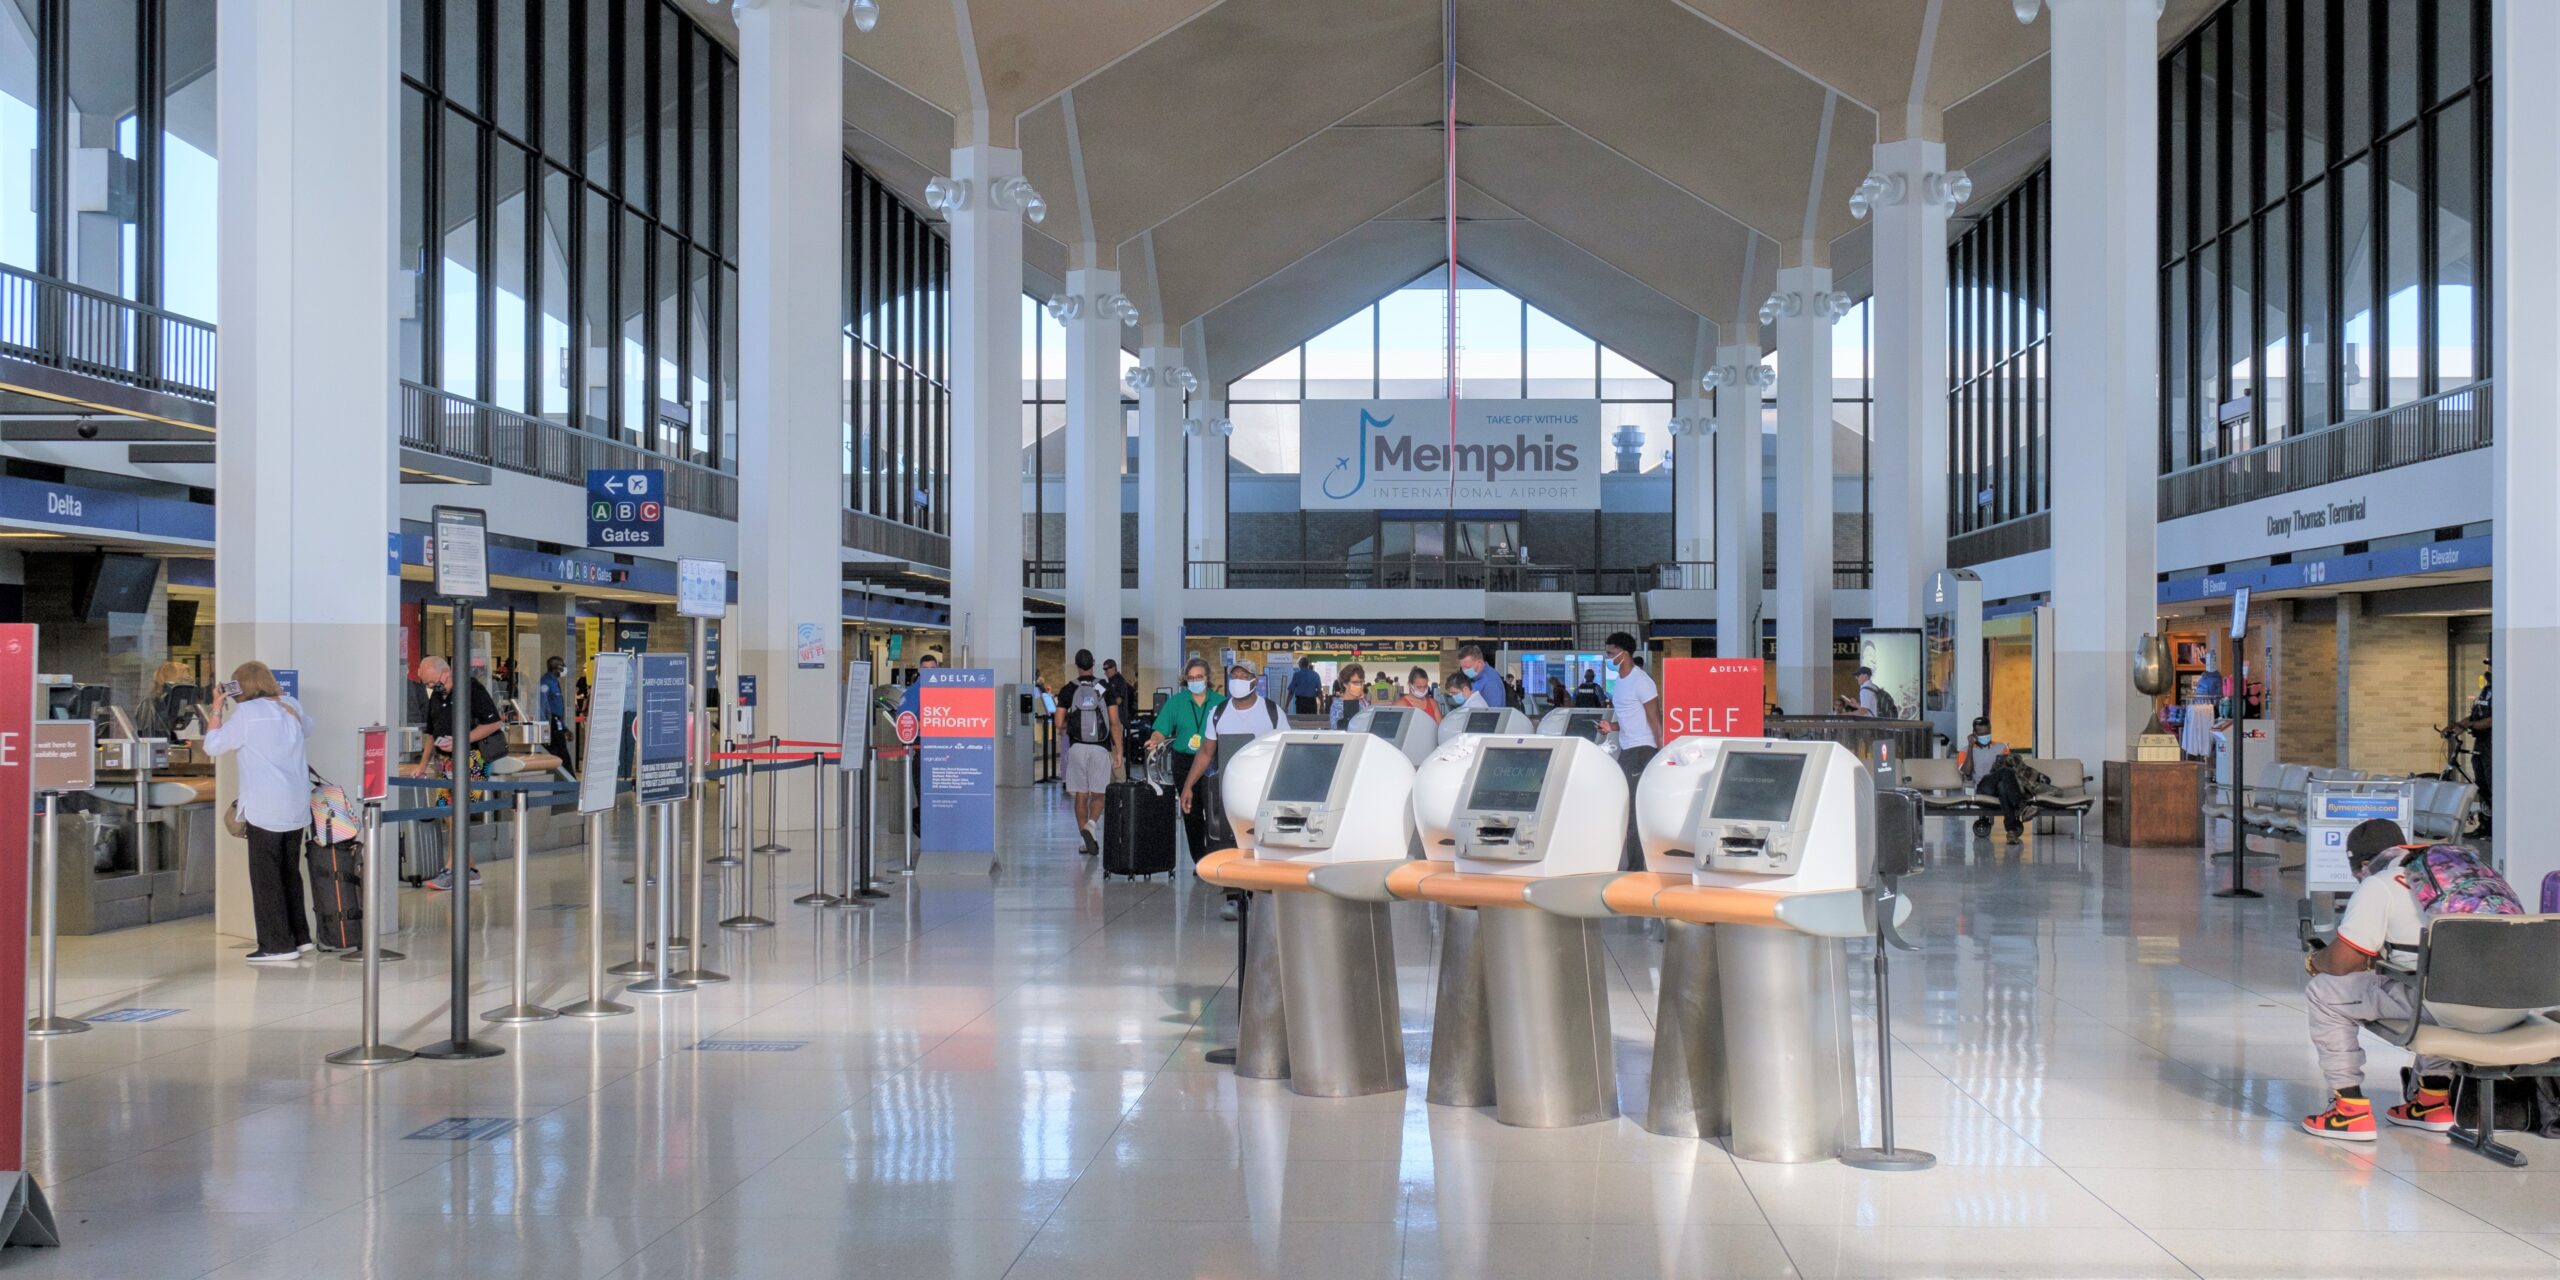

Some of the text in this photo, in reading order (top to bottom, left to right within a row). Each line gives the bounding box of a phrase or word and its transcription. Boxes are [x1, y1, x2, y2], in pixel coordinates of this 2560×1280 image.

[1486, 415, 1579, 424] TAKE OFF WITH US
[1374, 434, 1579, 482] Memphis
[1373, 487, 1578, 498] INTERNATIONAL AIRPORT
[48, 492, 82, 517] Delta
[595, 504, 656, 519] A B C
[2267, 496, 2366, 539] Danny Thomas Terminal
[601, 527, 650, 542] Gates
[2431, 548, 2460, 565] Elevator
[597, 567, 612, 582] Gates
[2209, 581, 2227, 593] Elevator
[1329, 626, 1366, 636] Ticketing
[1324, 642, 1358, 651] Ticketing
[1719, 665, 1749, 673] DELTA
[672, 677, 684, 686] CHECK
[940, 674, 976, 682] DELTA
[923, 706, 951, 717] SKY
[923, 717, 988, 728] PRIORITY
[1669, 707, 1740, 733] SELF
[2242, 729, 2267, 739] edEx
[58, 751, 77, 759] agent
[1493, 766, 1537, 777] CHECK IN
[2328, 803, 2397, 813] flymemphis.com
